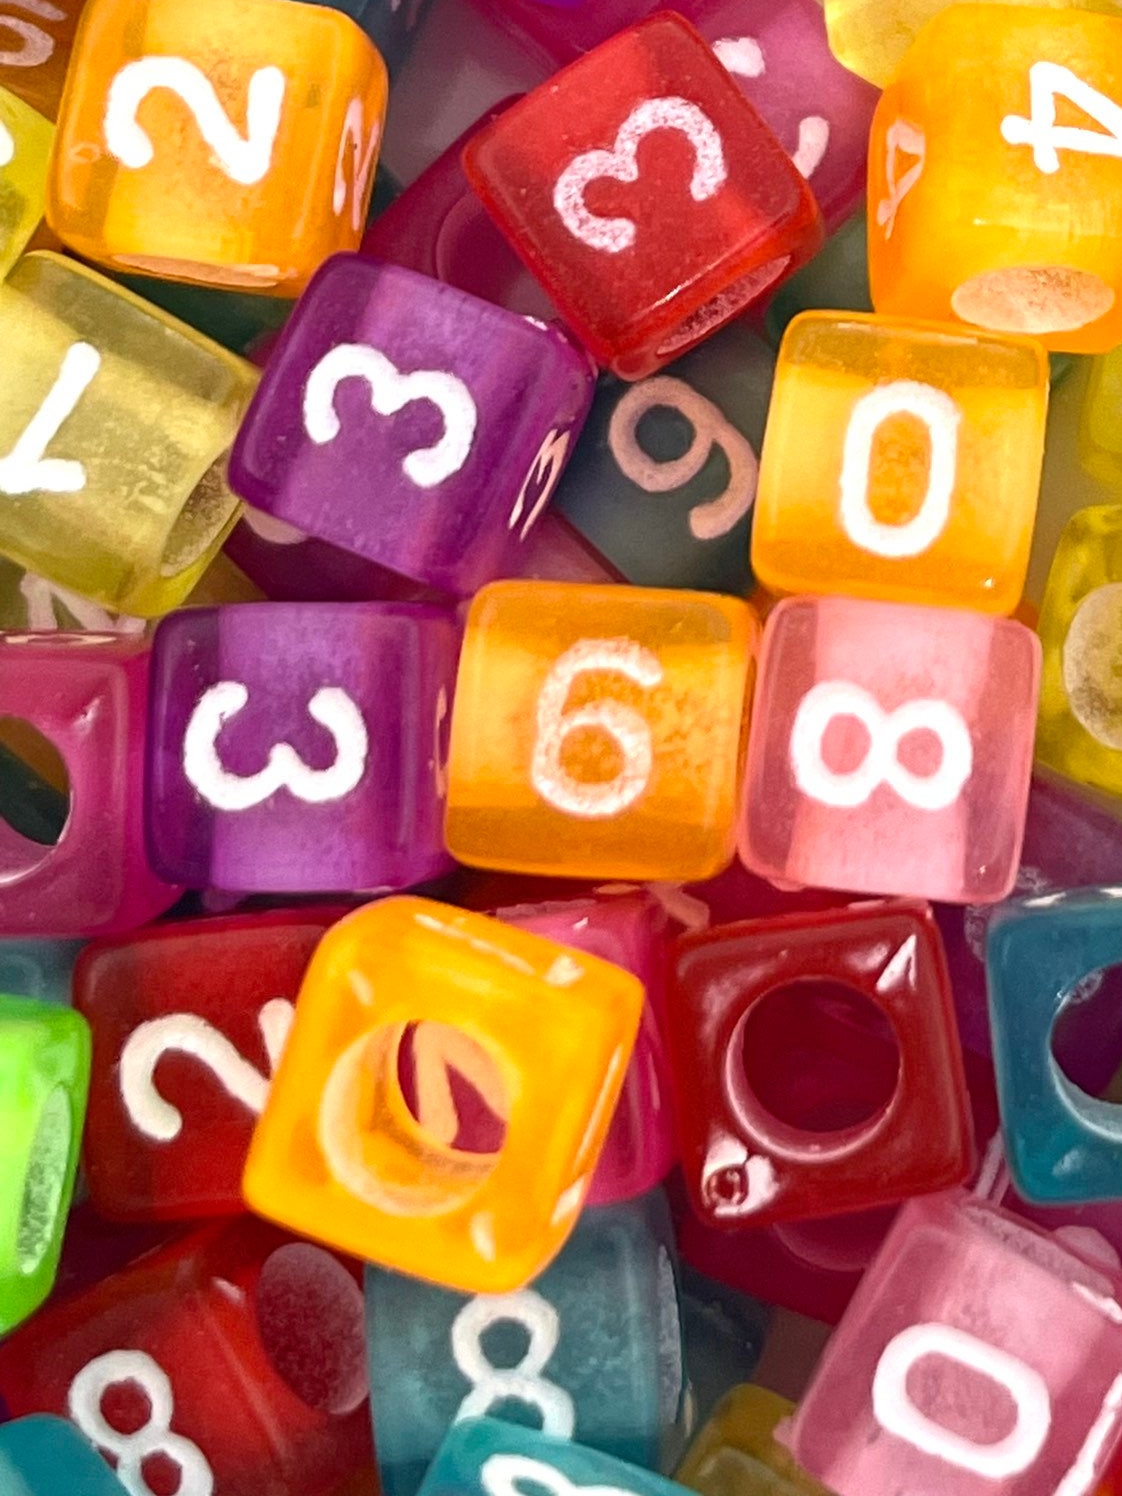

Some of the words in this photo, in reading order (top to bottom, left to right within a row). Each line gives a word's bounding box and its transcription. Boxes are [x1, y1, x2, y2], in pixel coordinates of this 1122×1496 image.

[103, 56, 286, 186] 2
[552, 95, 728, 253] 3
[302, 343, 478, 489] 3
[609, 375, 760, 541] 9
[839, 379, 962, 559] 0
[184, 681, 369, 812] 3
[531, 636, 664, 819] 6
[792, 680, 974, 811] 8
[119, 998, 296, 1141] 2
[68, 1349, 214, 1496] 8
[871, 1321, 1052, 1481] 0
